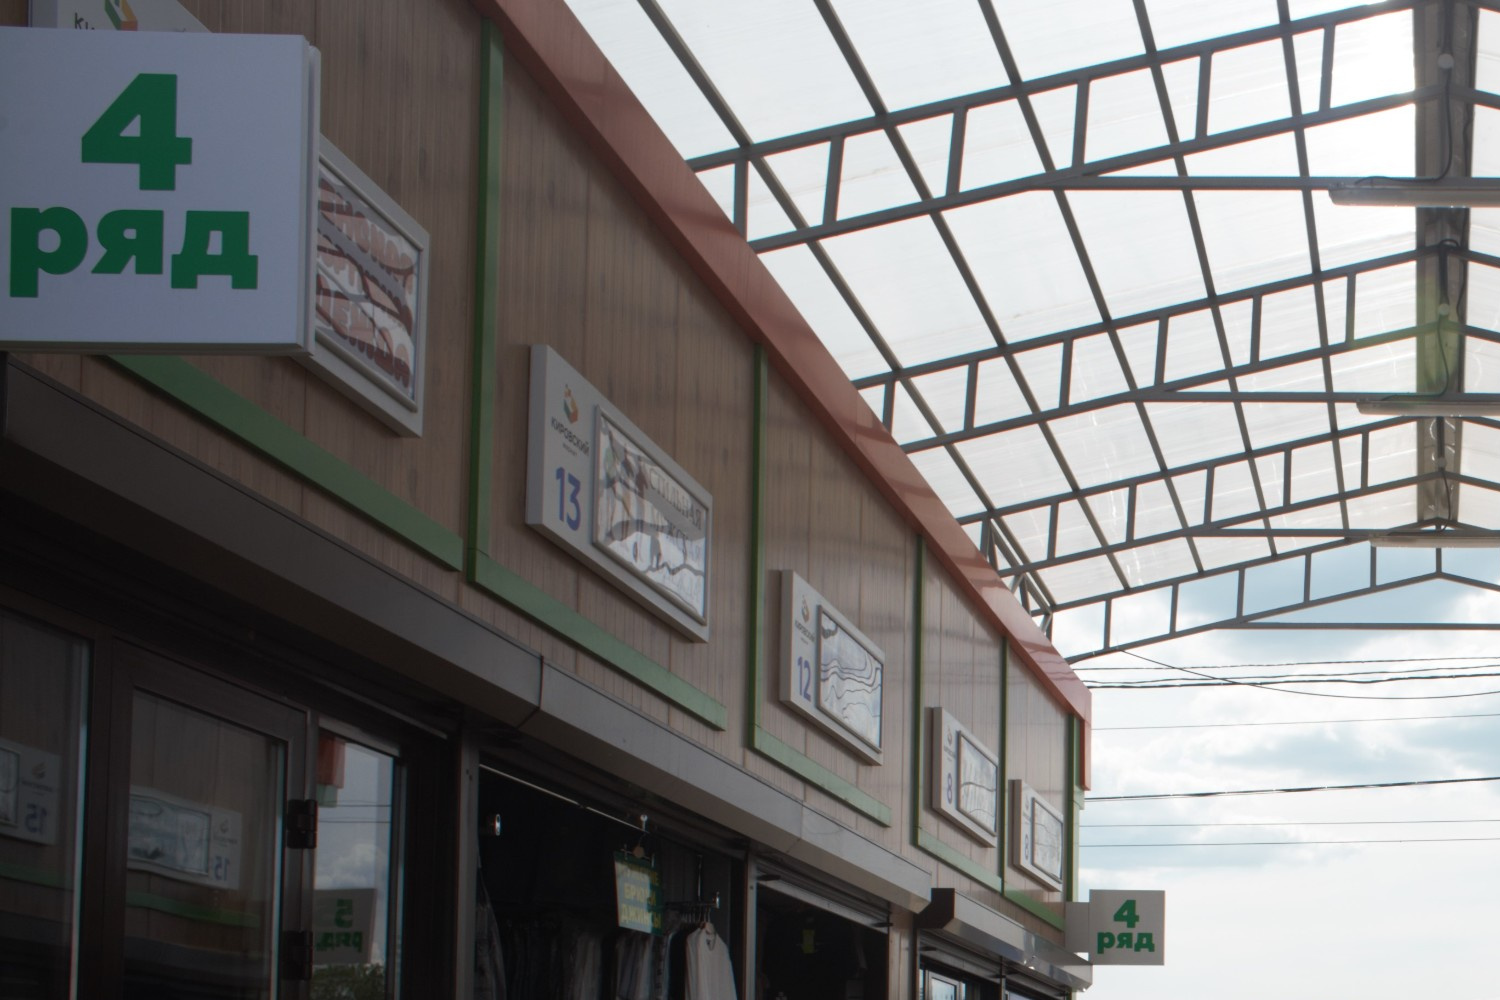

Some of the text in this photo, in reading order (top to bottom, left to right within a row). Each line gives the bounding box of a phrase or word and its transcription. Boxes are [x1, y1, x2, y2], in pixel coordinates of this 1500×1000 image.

[81, 73, 192, 191] 4
[10, 206, 258, 298] ряд
[551, 416, 590, 457] КИРОВСКИЙ
[556, 466, 581, 532] 13
[797, 656, 811, 703] 12
[947, 772, 953, 805] 8
[1113, 899, 1140, 928] 4
[1097, 931, 1155, 954] ряд
